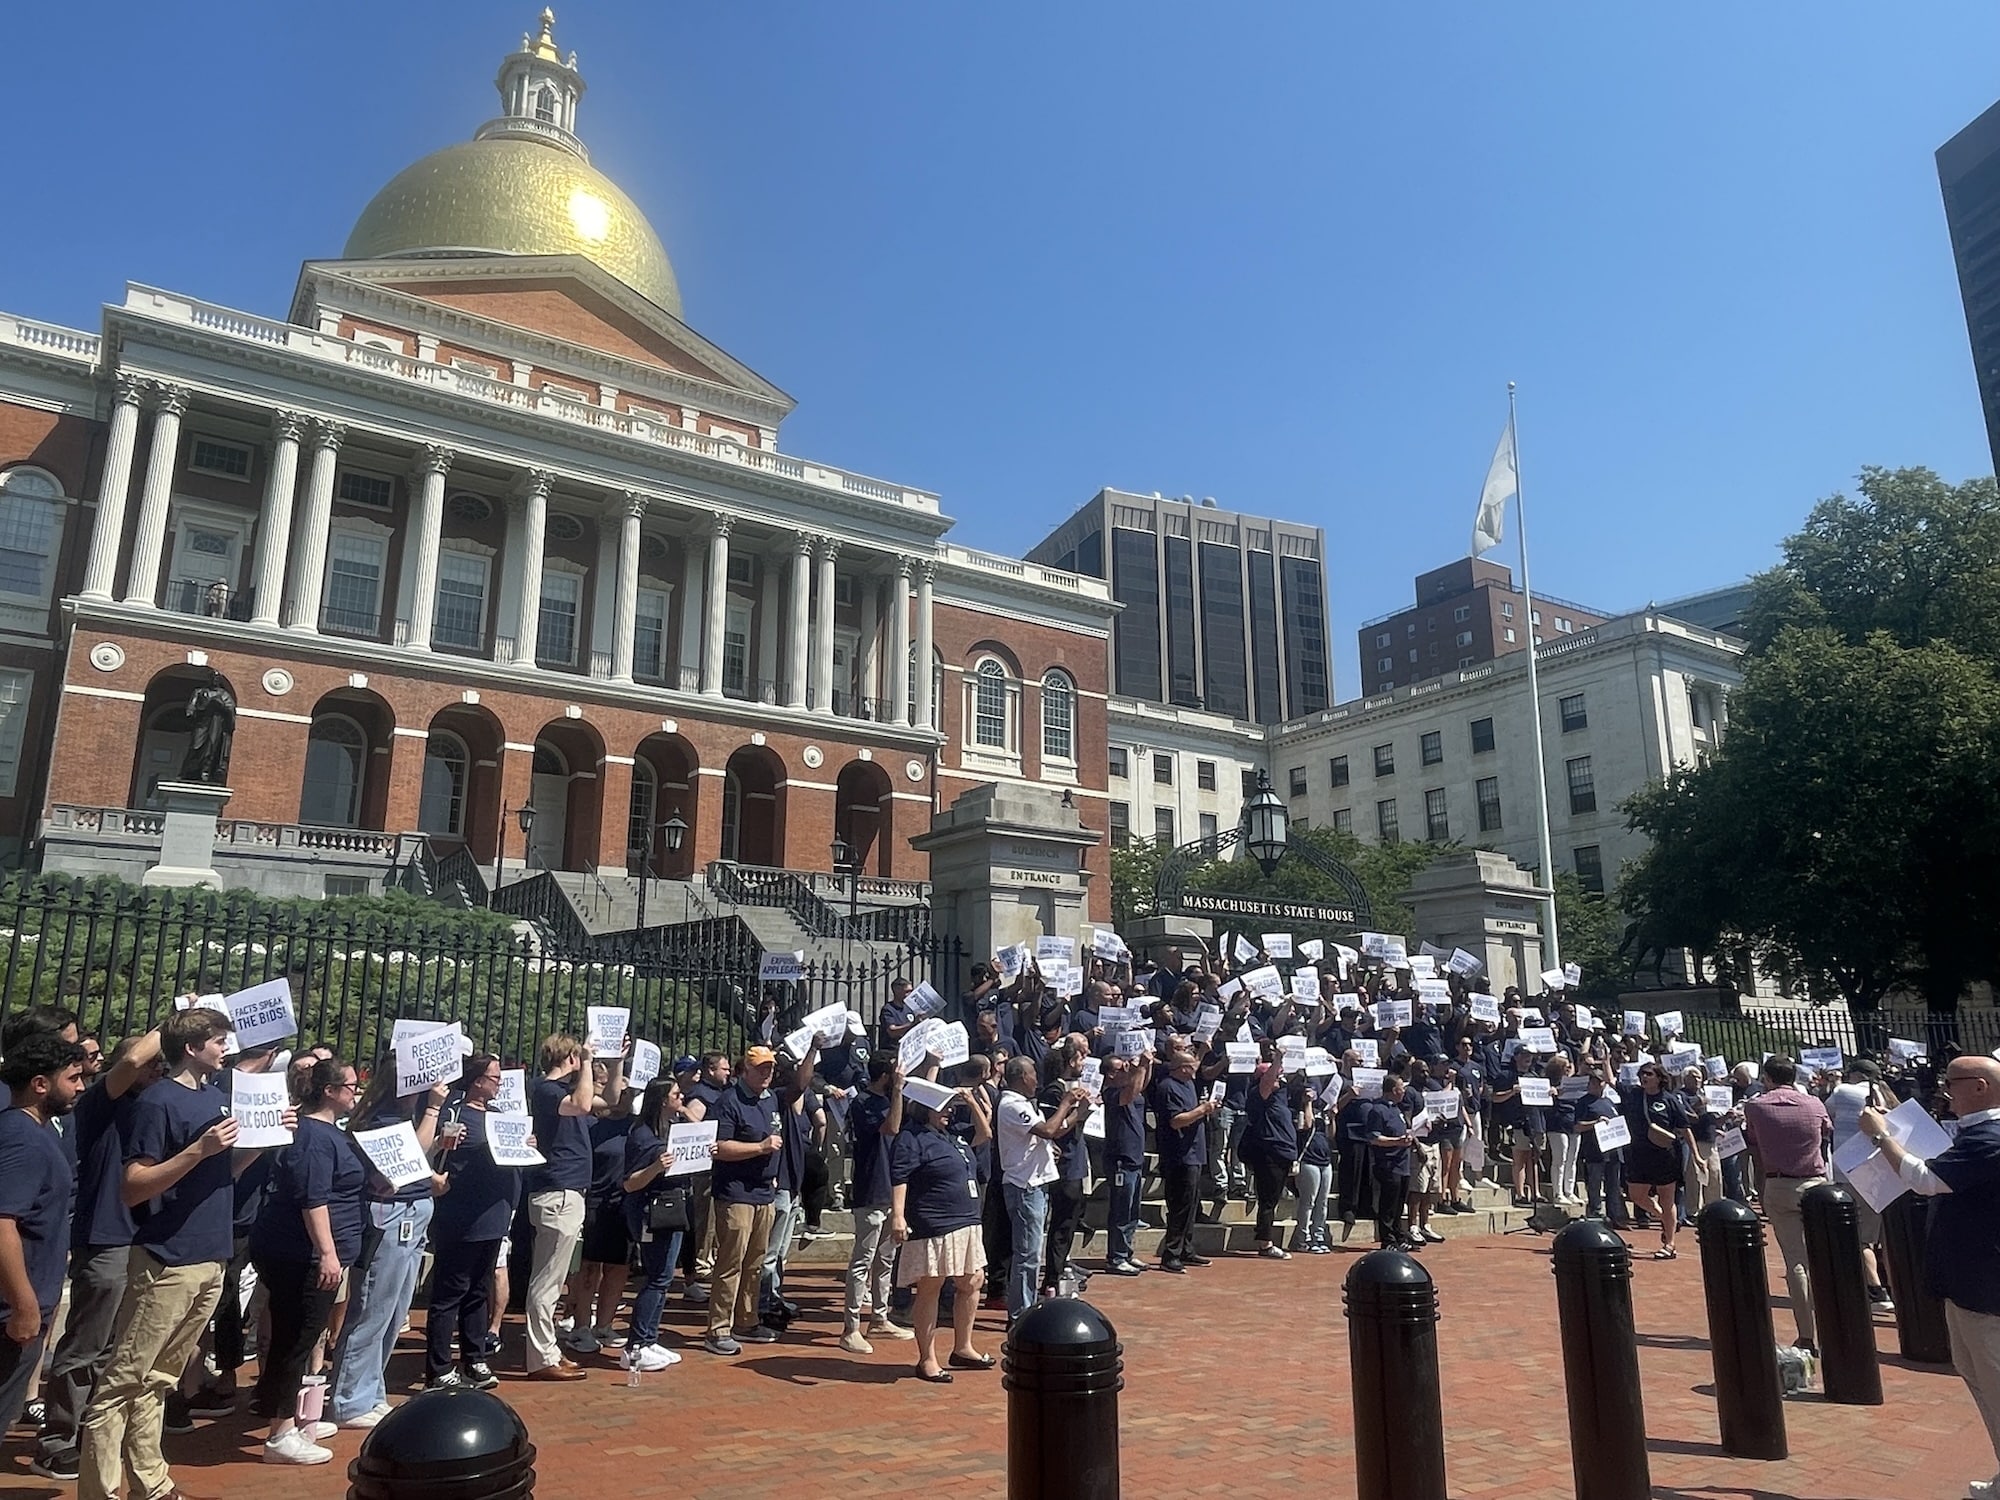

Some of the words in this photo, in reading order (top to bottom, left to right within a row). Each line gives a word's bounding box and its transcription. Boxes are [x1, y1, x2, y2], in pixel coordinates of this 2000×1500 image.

[1010, 870, 1061, 884] ENTRANCE
[1182, 895, 1281, 915] MASSACHUSETTS
[1283, 905, 1316, 919] STATE
[1318, 908, 1355, 922] HOUSE
[235, 1003, 258, 1017] FACTS
[259, 996, 283, 1011] SPEAK
[237, 1015, 258, 1031] THE
[259, 1006, 287, 1025] BIDS!
[411, 1033, 455, 1059] RESIDENTS
[1121, 1043, 1132, 1052] WE
[1133, 1041, 1144, 1051] CA
[417, 1047, 453, 1071] DESERVE
[254, 1109, 284, 1129] GOOD
[494, 1120, 526, 1135] RESIDENTS
